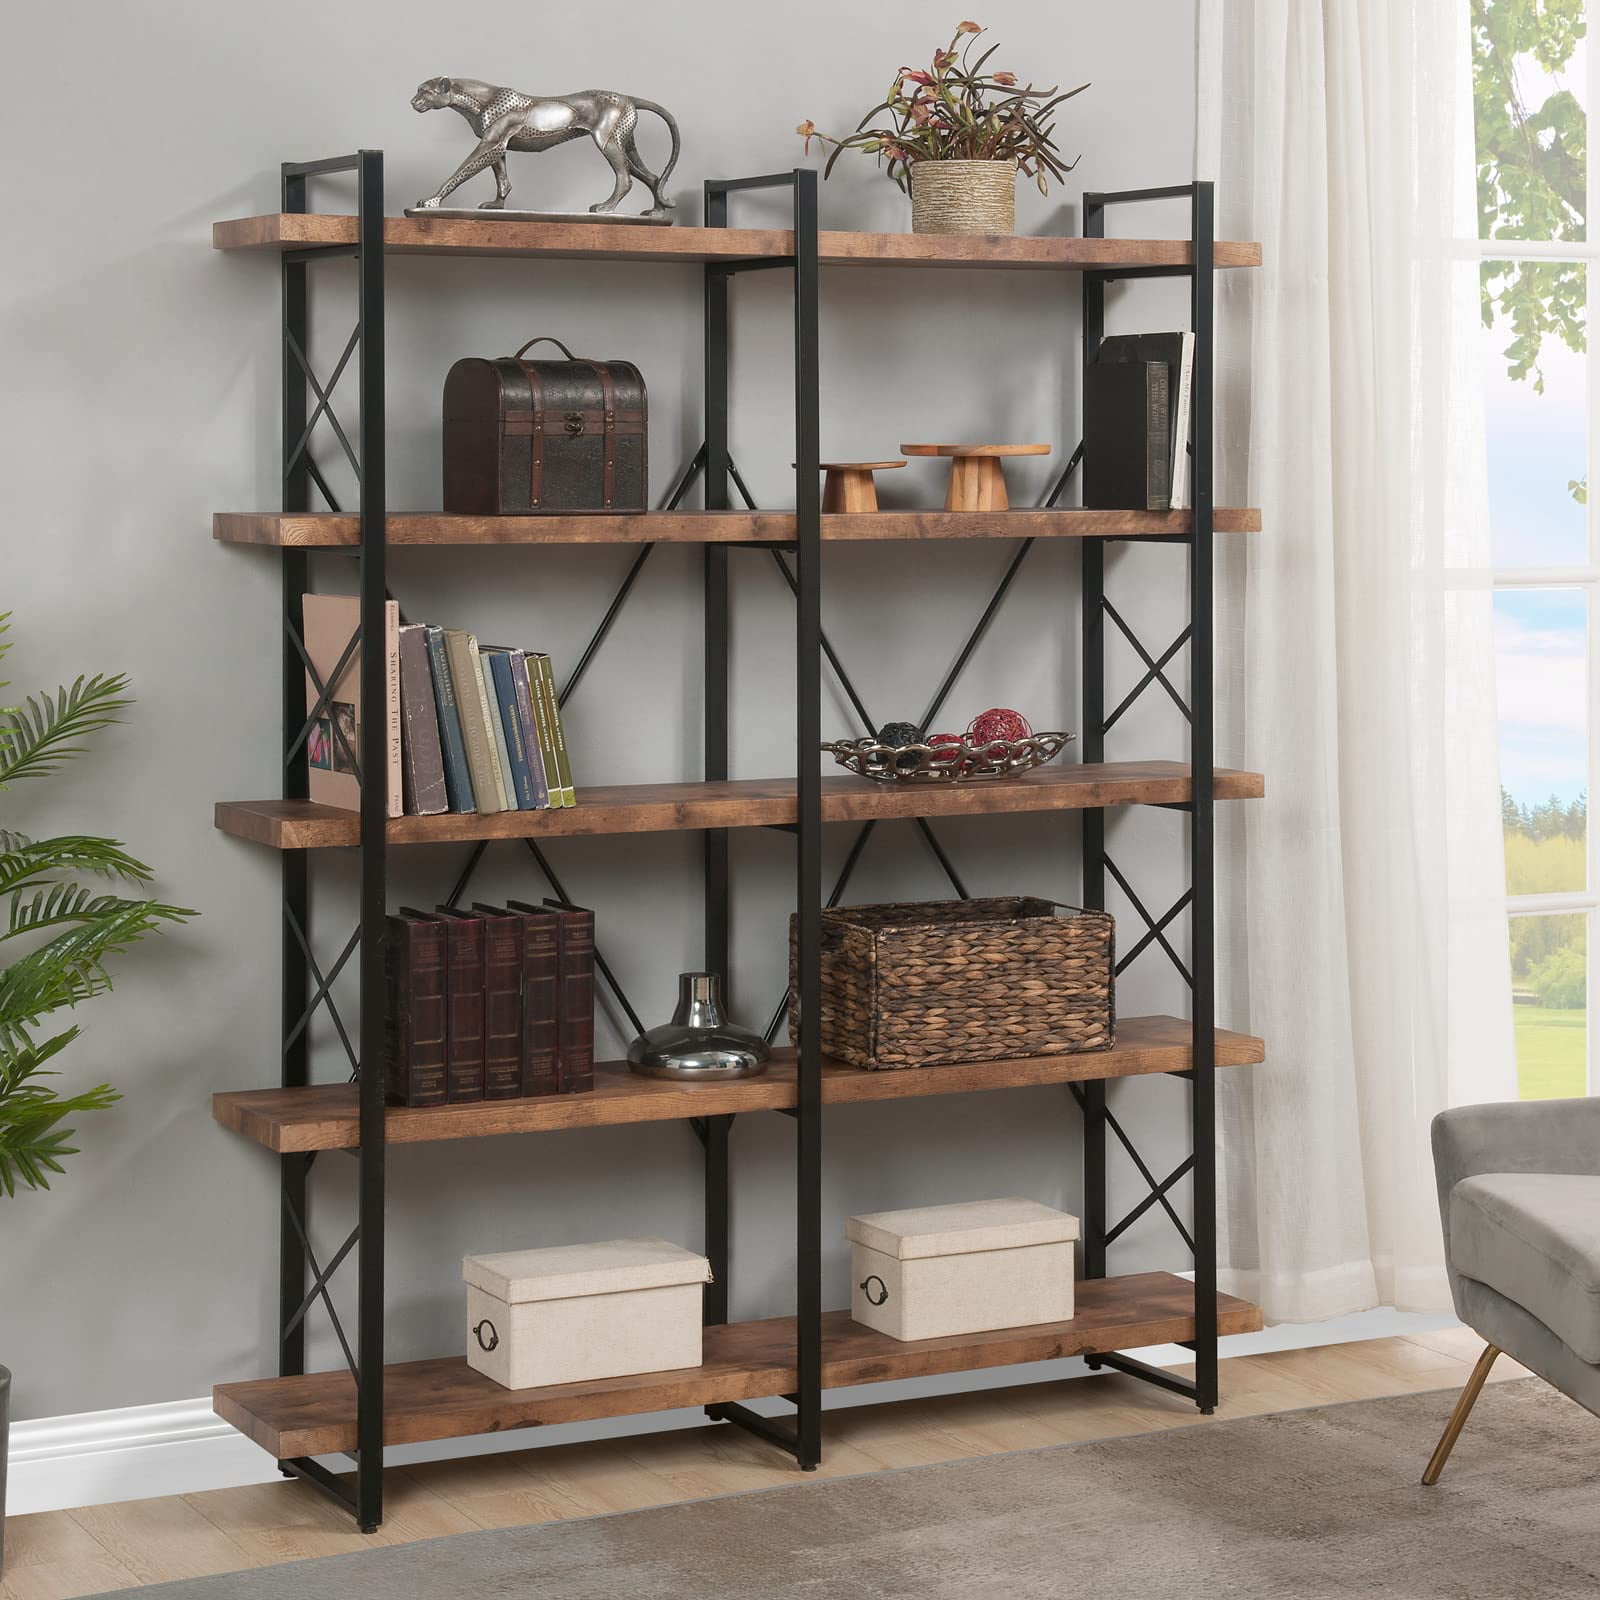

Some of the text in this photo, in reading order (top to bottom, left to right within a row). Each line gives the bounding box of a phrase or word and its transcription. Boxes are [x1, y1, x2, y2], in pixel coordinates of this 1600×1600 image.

[1151, 381, 1159, 402] THE
[390, 652, 398, 703] SHARING
[475, 667, 493, 738] oils vinegars
